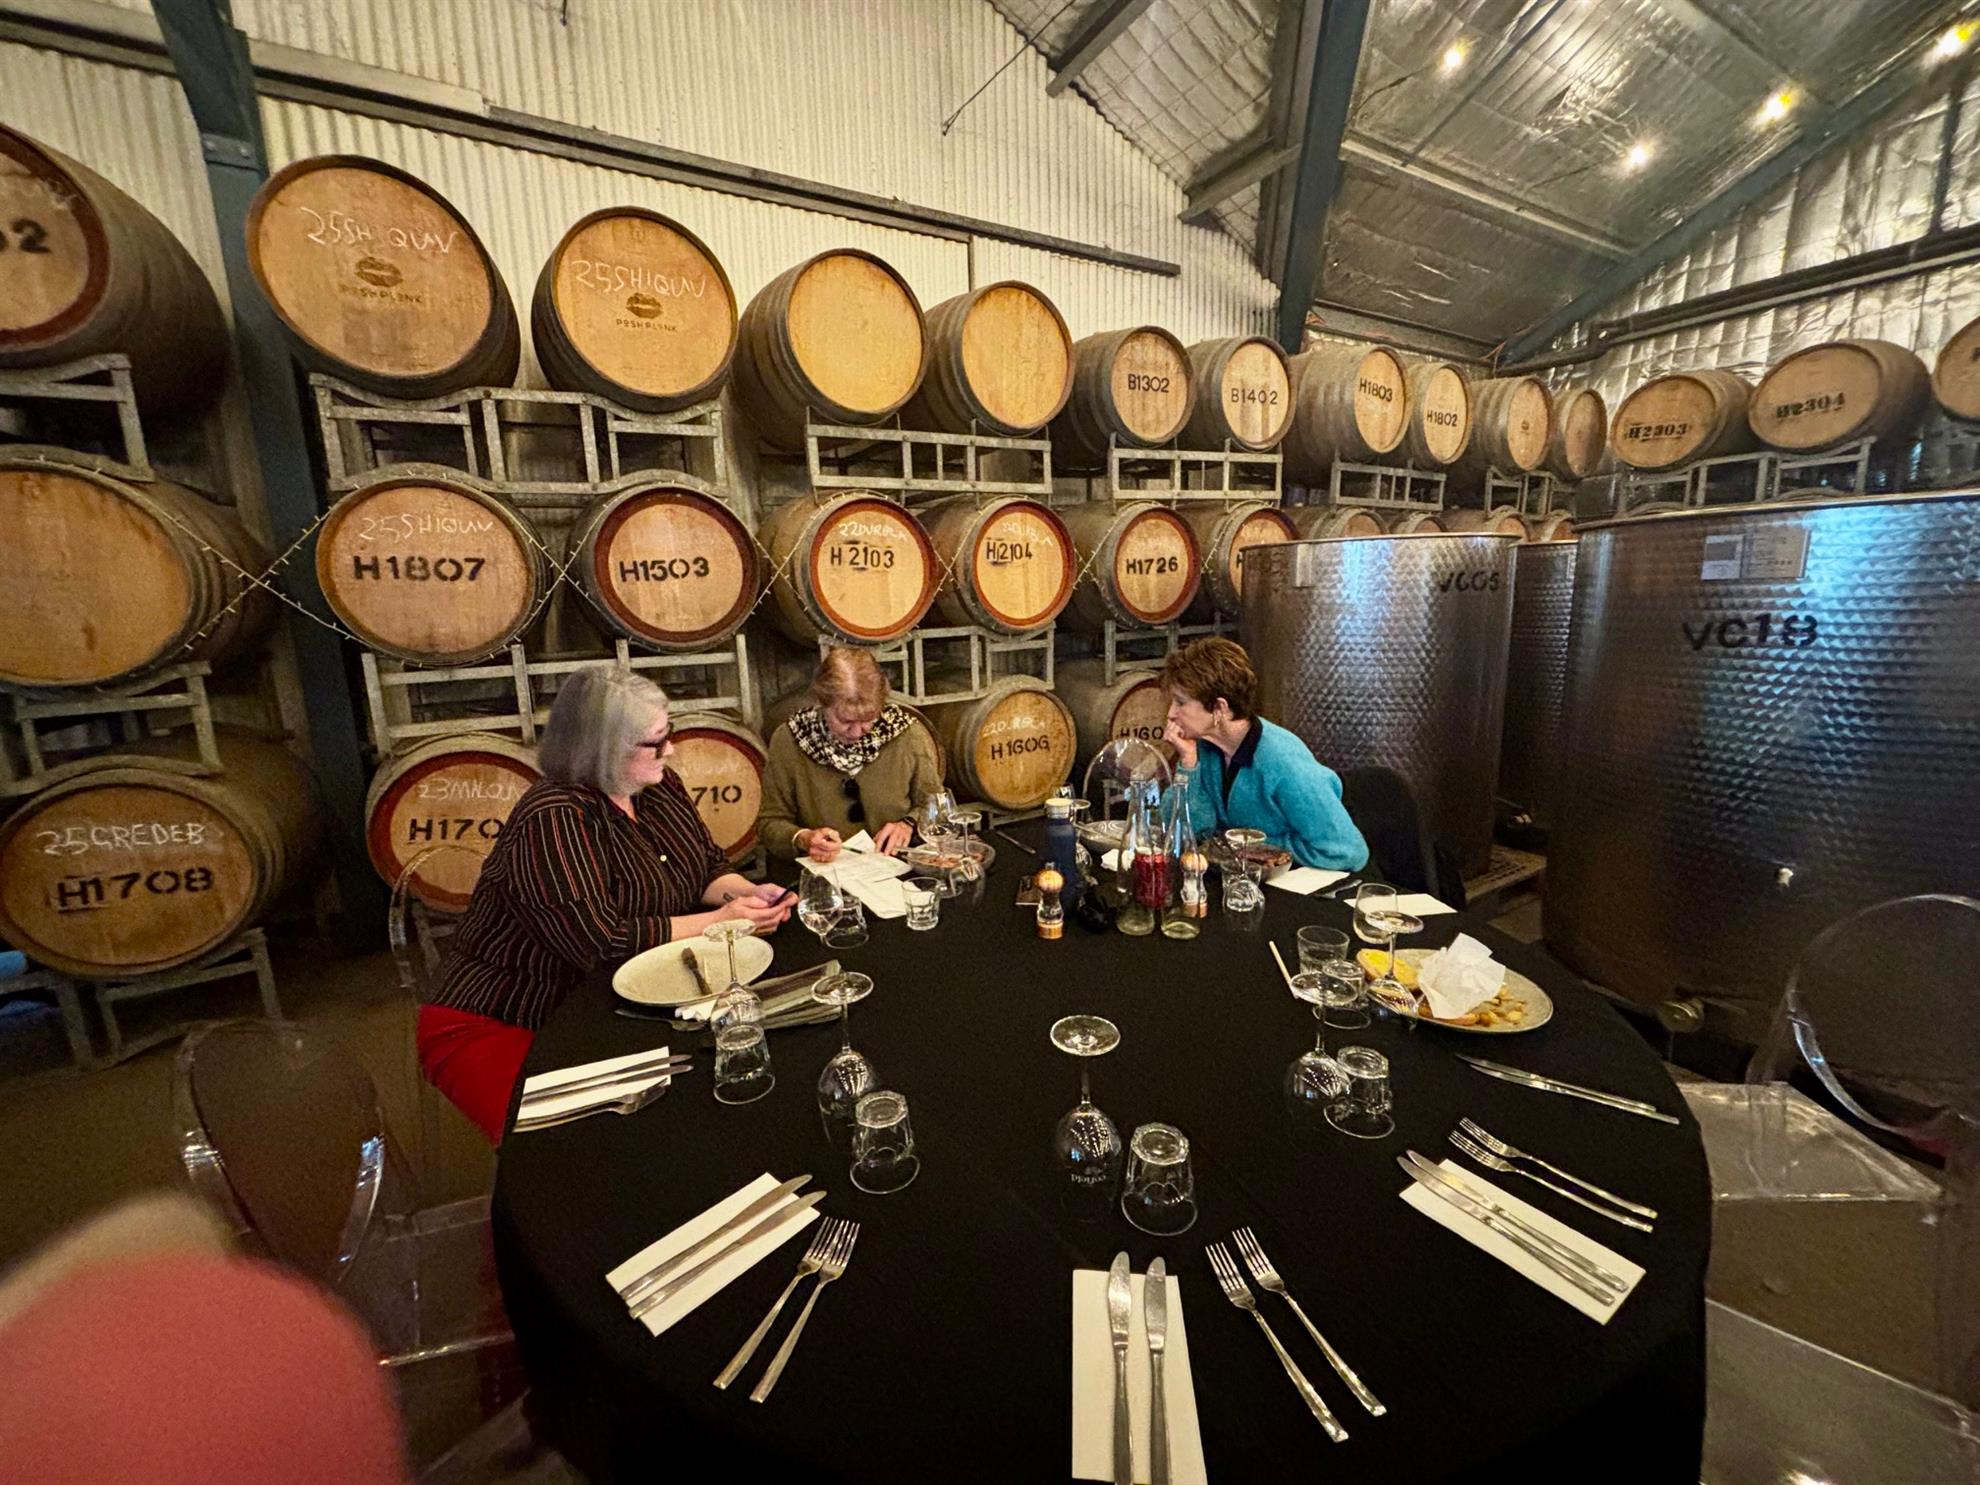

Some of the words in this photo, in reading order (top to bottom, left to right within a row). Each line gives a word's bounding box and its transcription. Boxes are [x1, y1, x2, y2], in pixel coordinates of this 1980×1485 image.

[1127, 373, 1170, 394] B1302
[1358, 376, 1394, 403] H1803
[1230, 387, 1279, 405] B1402
[1425, 409, 1459, 428] H1802
[352, 555, 487, 582] H1807
[618, 556, 711, 583] H1503
[1125, 556, 1179, 575] H1726
[1681, 613, 1819, 651] VC18
[1119, 726, 1165, 741] H160
[690, 784, 743, 807] 710
[407, 817, 506, 841] H170
[56, 867, 214, 908] H1708
